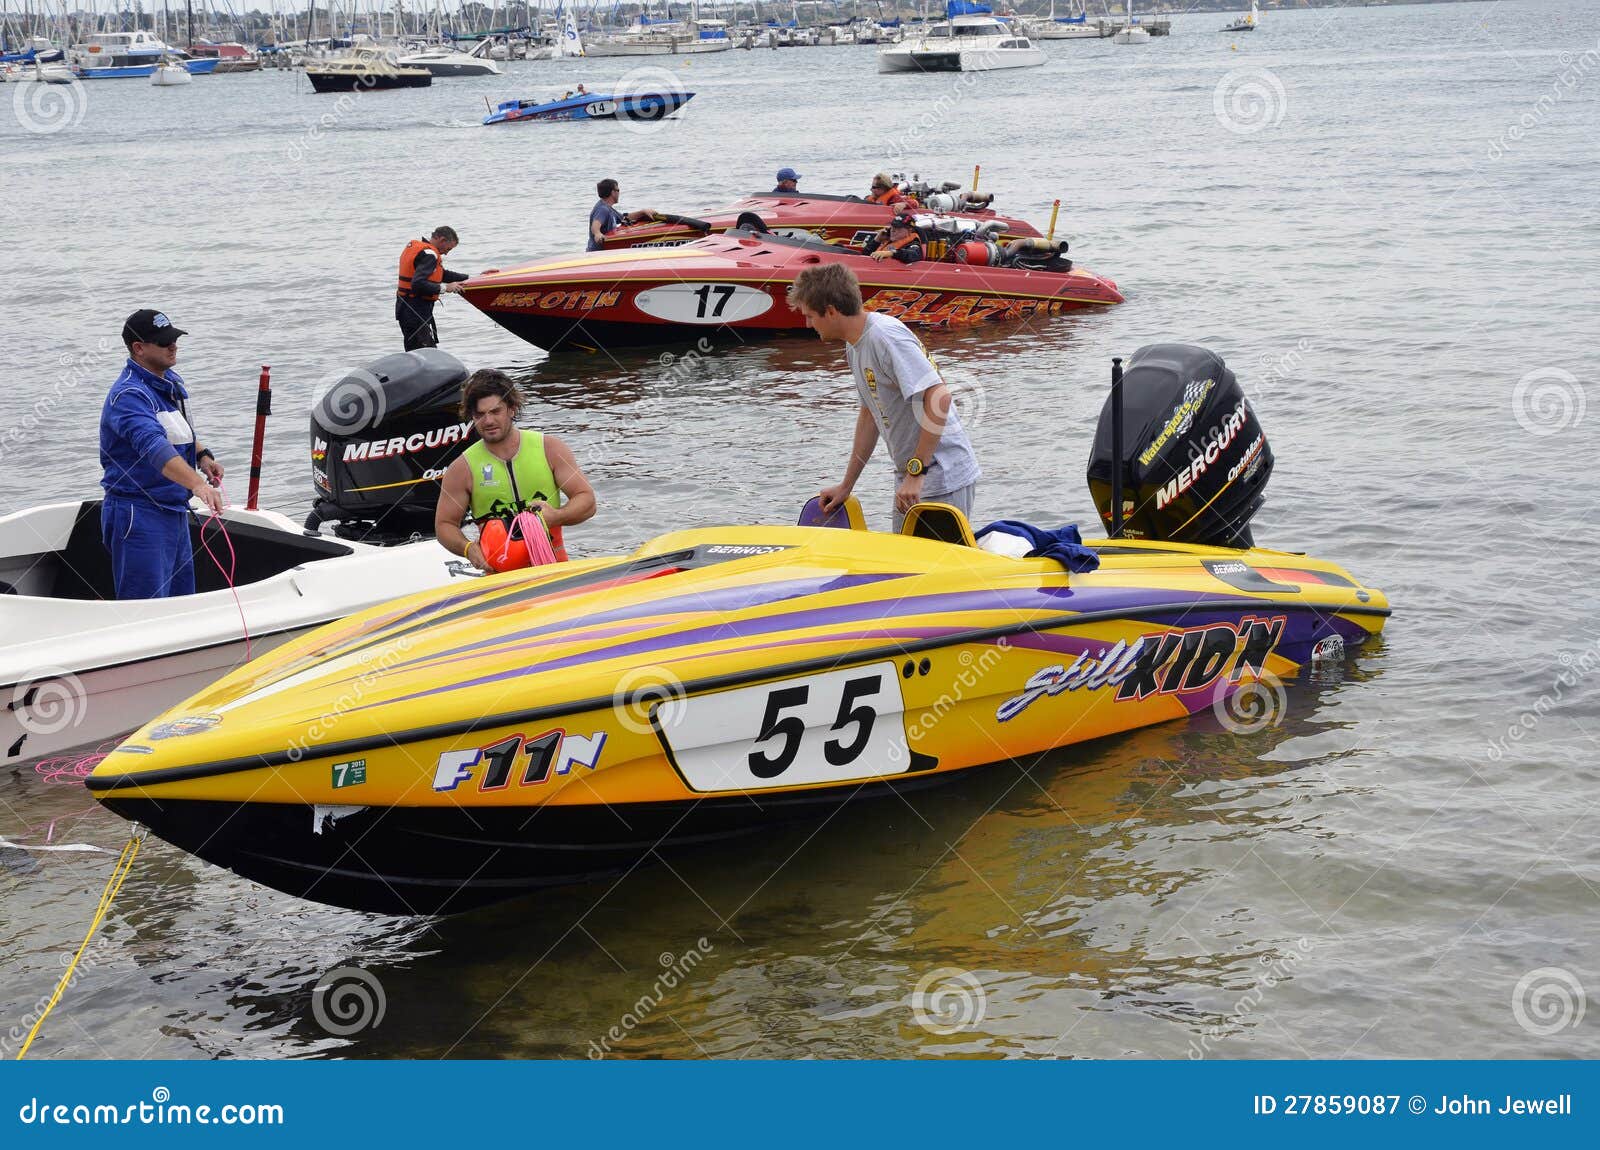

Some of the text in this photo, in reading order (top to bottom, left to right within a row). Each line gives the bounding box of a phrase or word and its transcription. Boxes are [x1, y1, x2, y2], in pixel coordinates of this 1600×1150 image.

[591, 101, 606, 115] 14
[693, 284, 737, 319] 17
[342, 420, 475, 462] MERCURY
[1156, 397, 1248, 510] MERCURY
[707, 545, 785, 554] BERNICO
[1212, 563, 1247, 574] BERNICO
[748, 674, 882, 779] 55
[334, 763, 349, 787] 7
[432, 727, 608, 793] F11N
